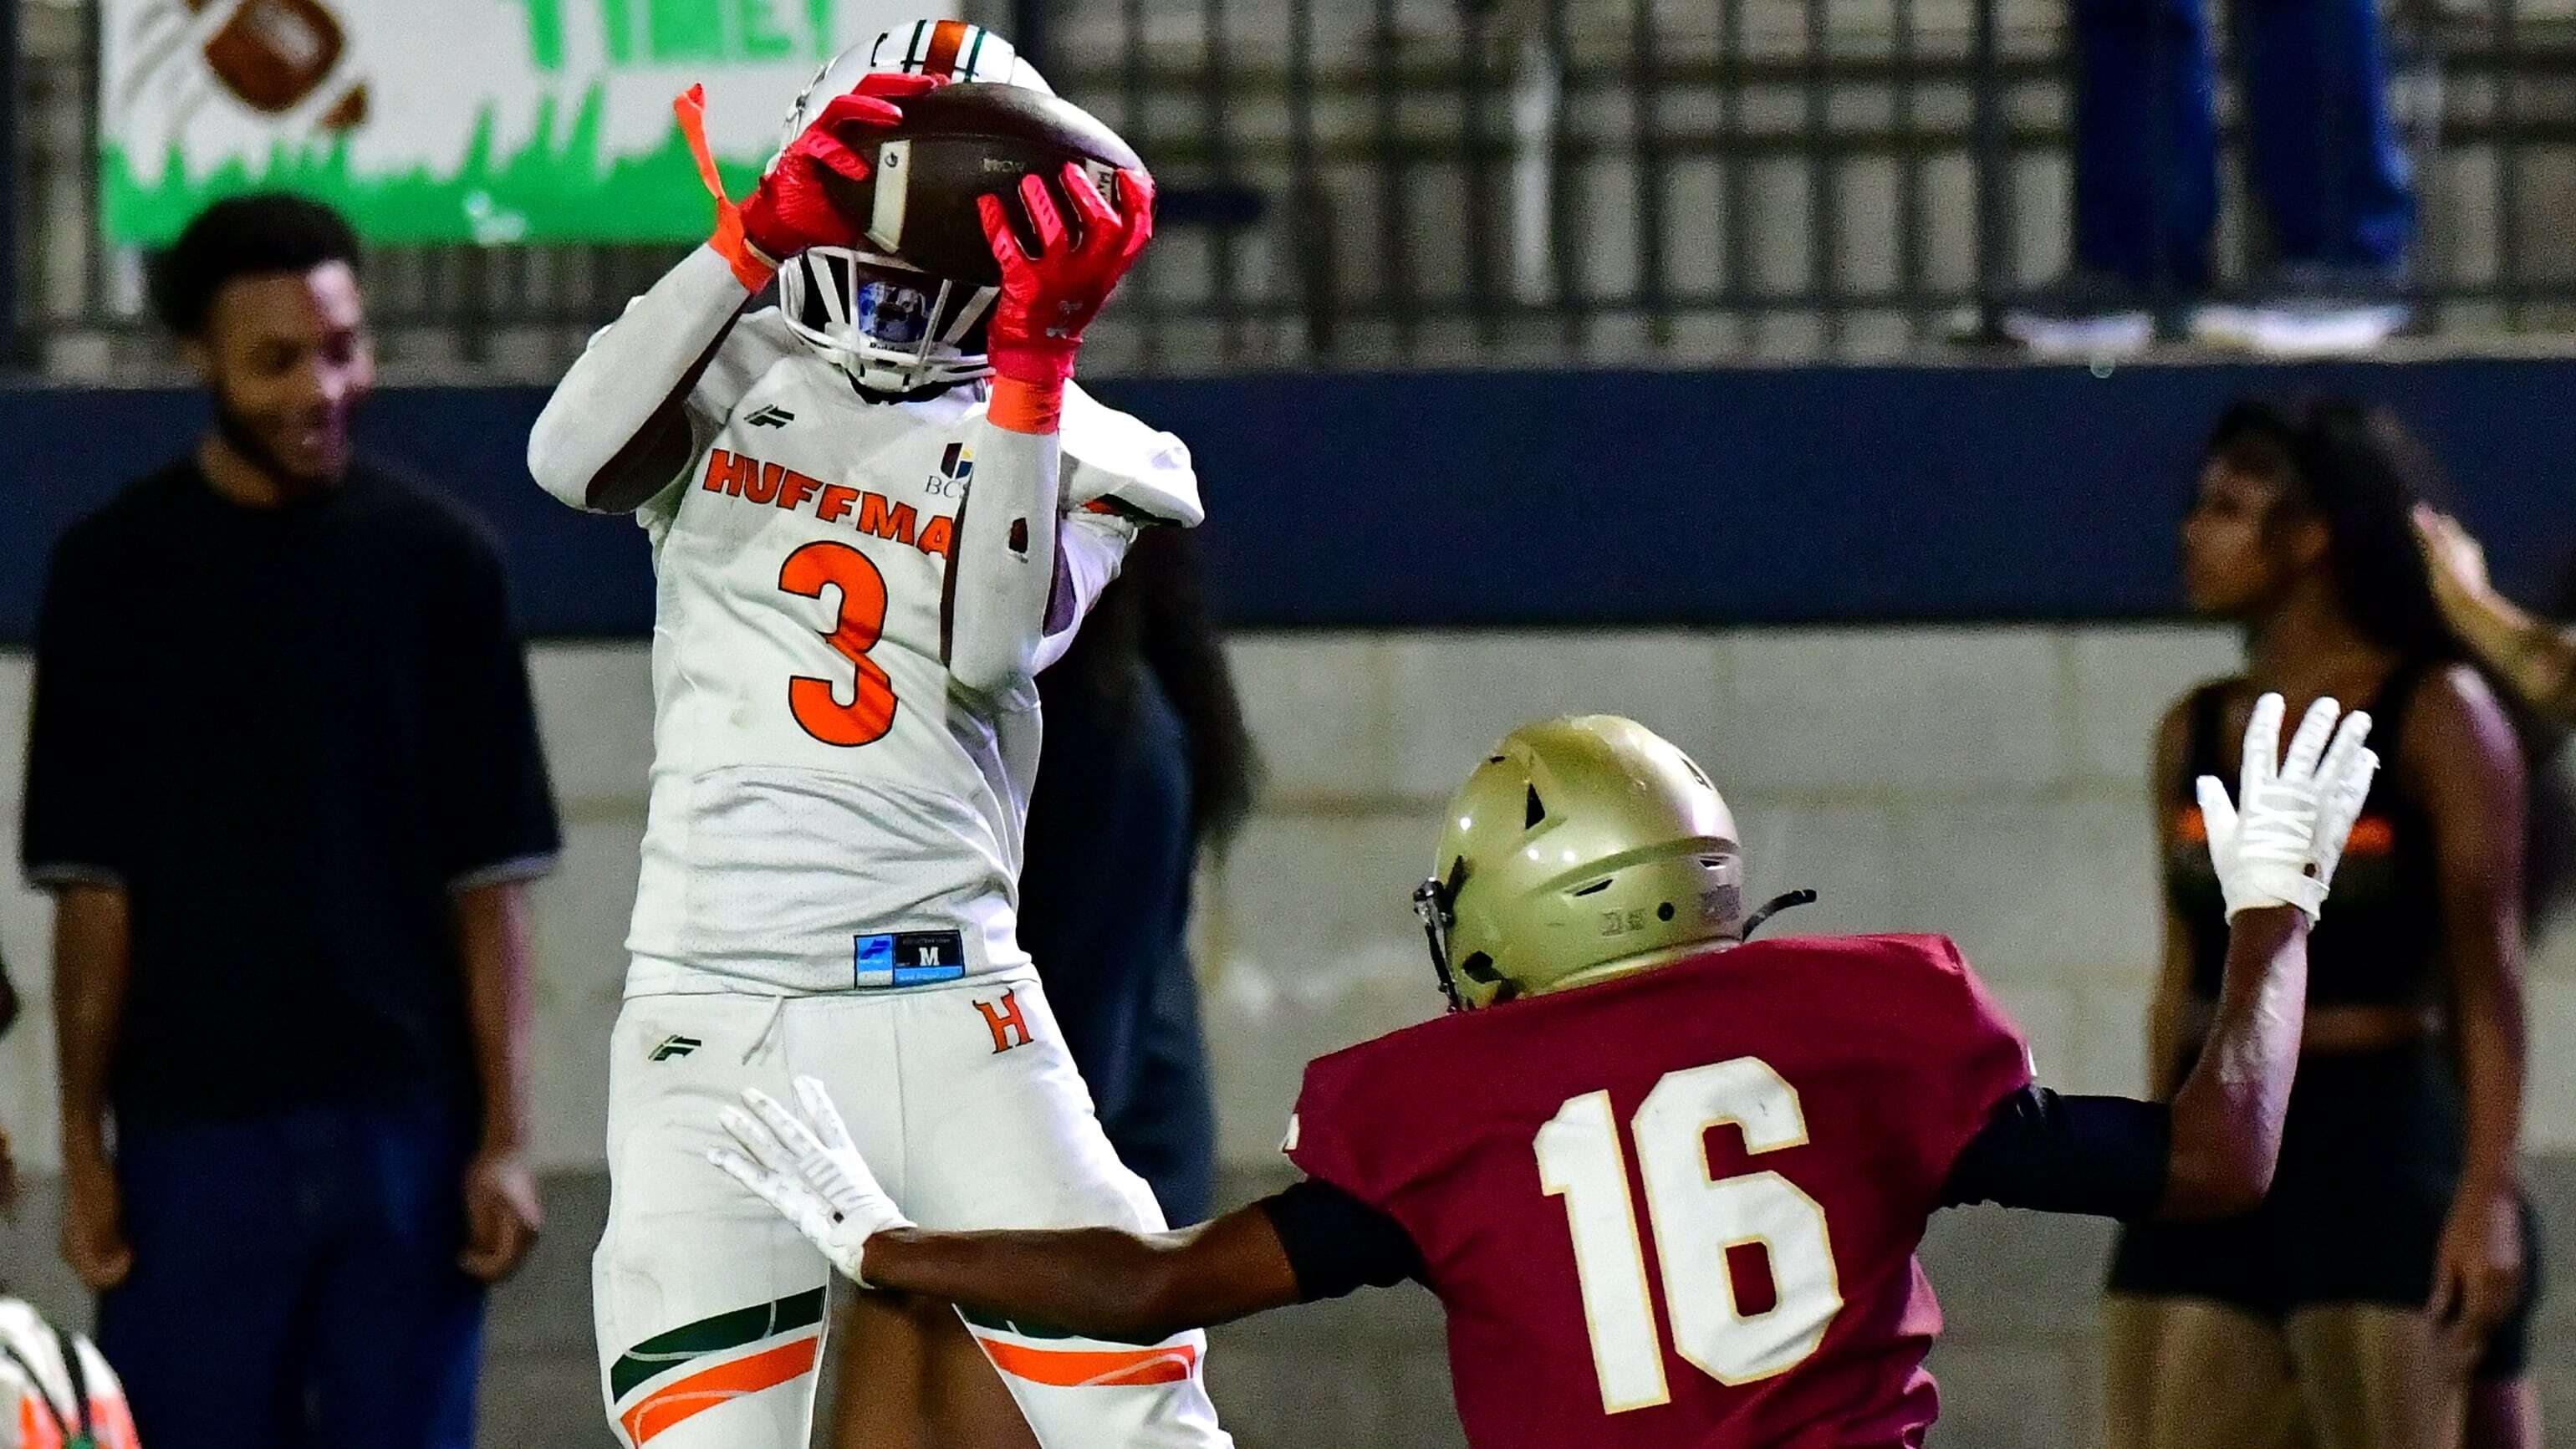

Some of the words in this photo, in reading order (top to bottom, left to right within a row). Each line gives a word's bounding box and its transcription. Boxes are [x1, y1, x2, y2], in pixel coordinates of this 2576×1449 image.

[778, 540, 898, 747] 3
[919, 946, 940, 966] M
[972, 987, 1034, 1054] H
[1533, 1056, 1844, 1415] 16
